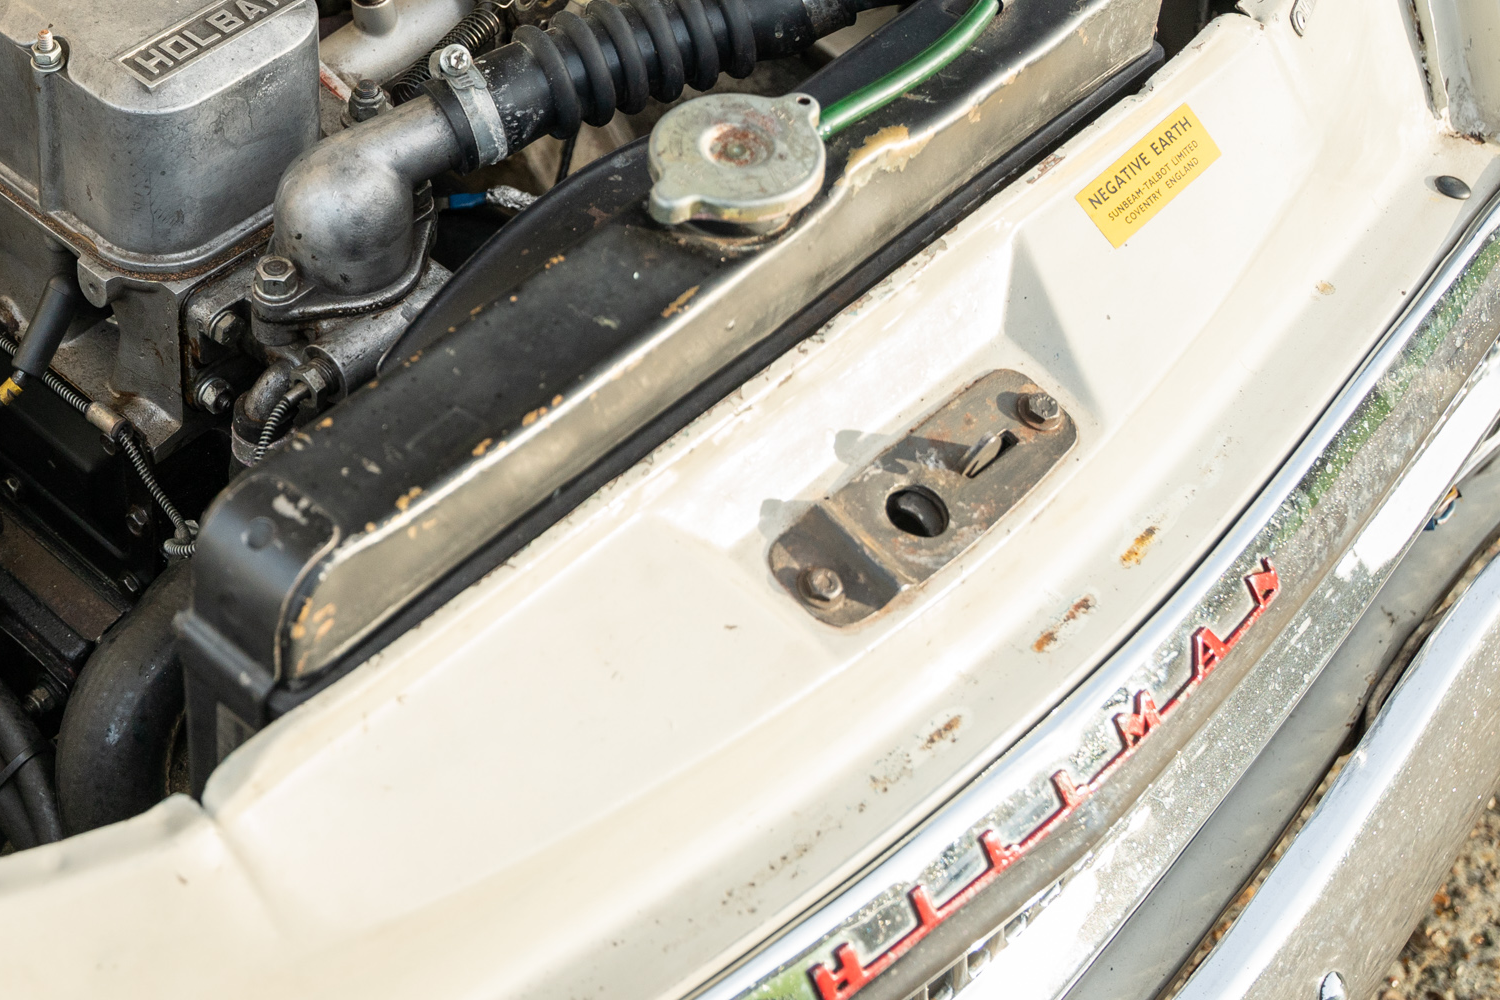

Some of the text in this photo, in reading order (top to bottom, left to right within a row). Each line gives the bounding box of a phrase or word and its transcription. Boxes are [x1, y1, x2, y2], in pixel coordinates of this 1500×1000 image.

[1087, 116, 1193, 210] NEGATIVE EARTH
[1108, 140, 1199, 221] SUNBEAM-TALBOT LIMITED
[1125, 157, 1199, 225] COVENTRY ENGLAND
[805, 556, 1280, 1000] HILLMAN
